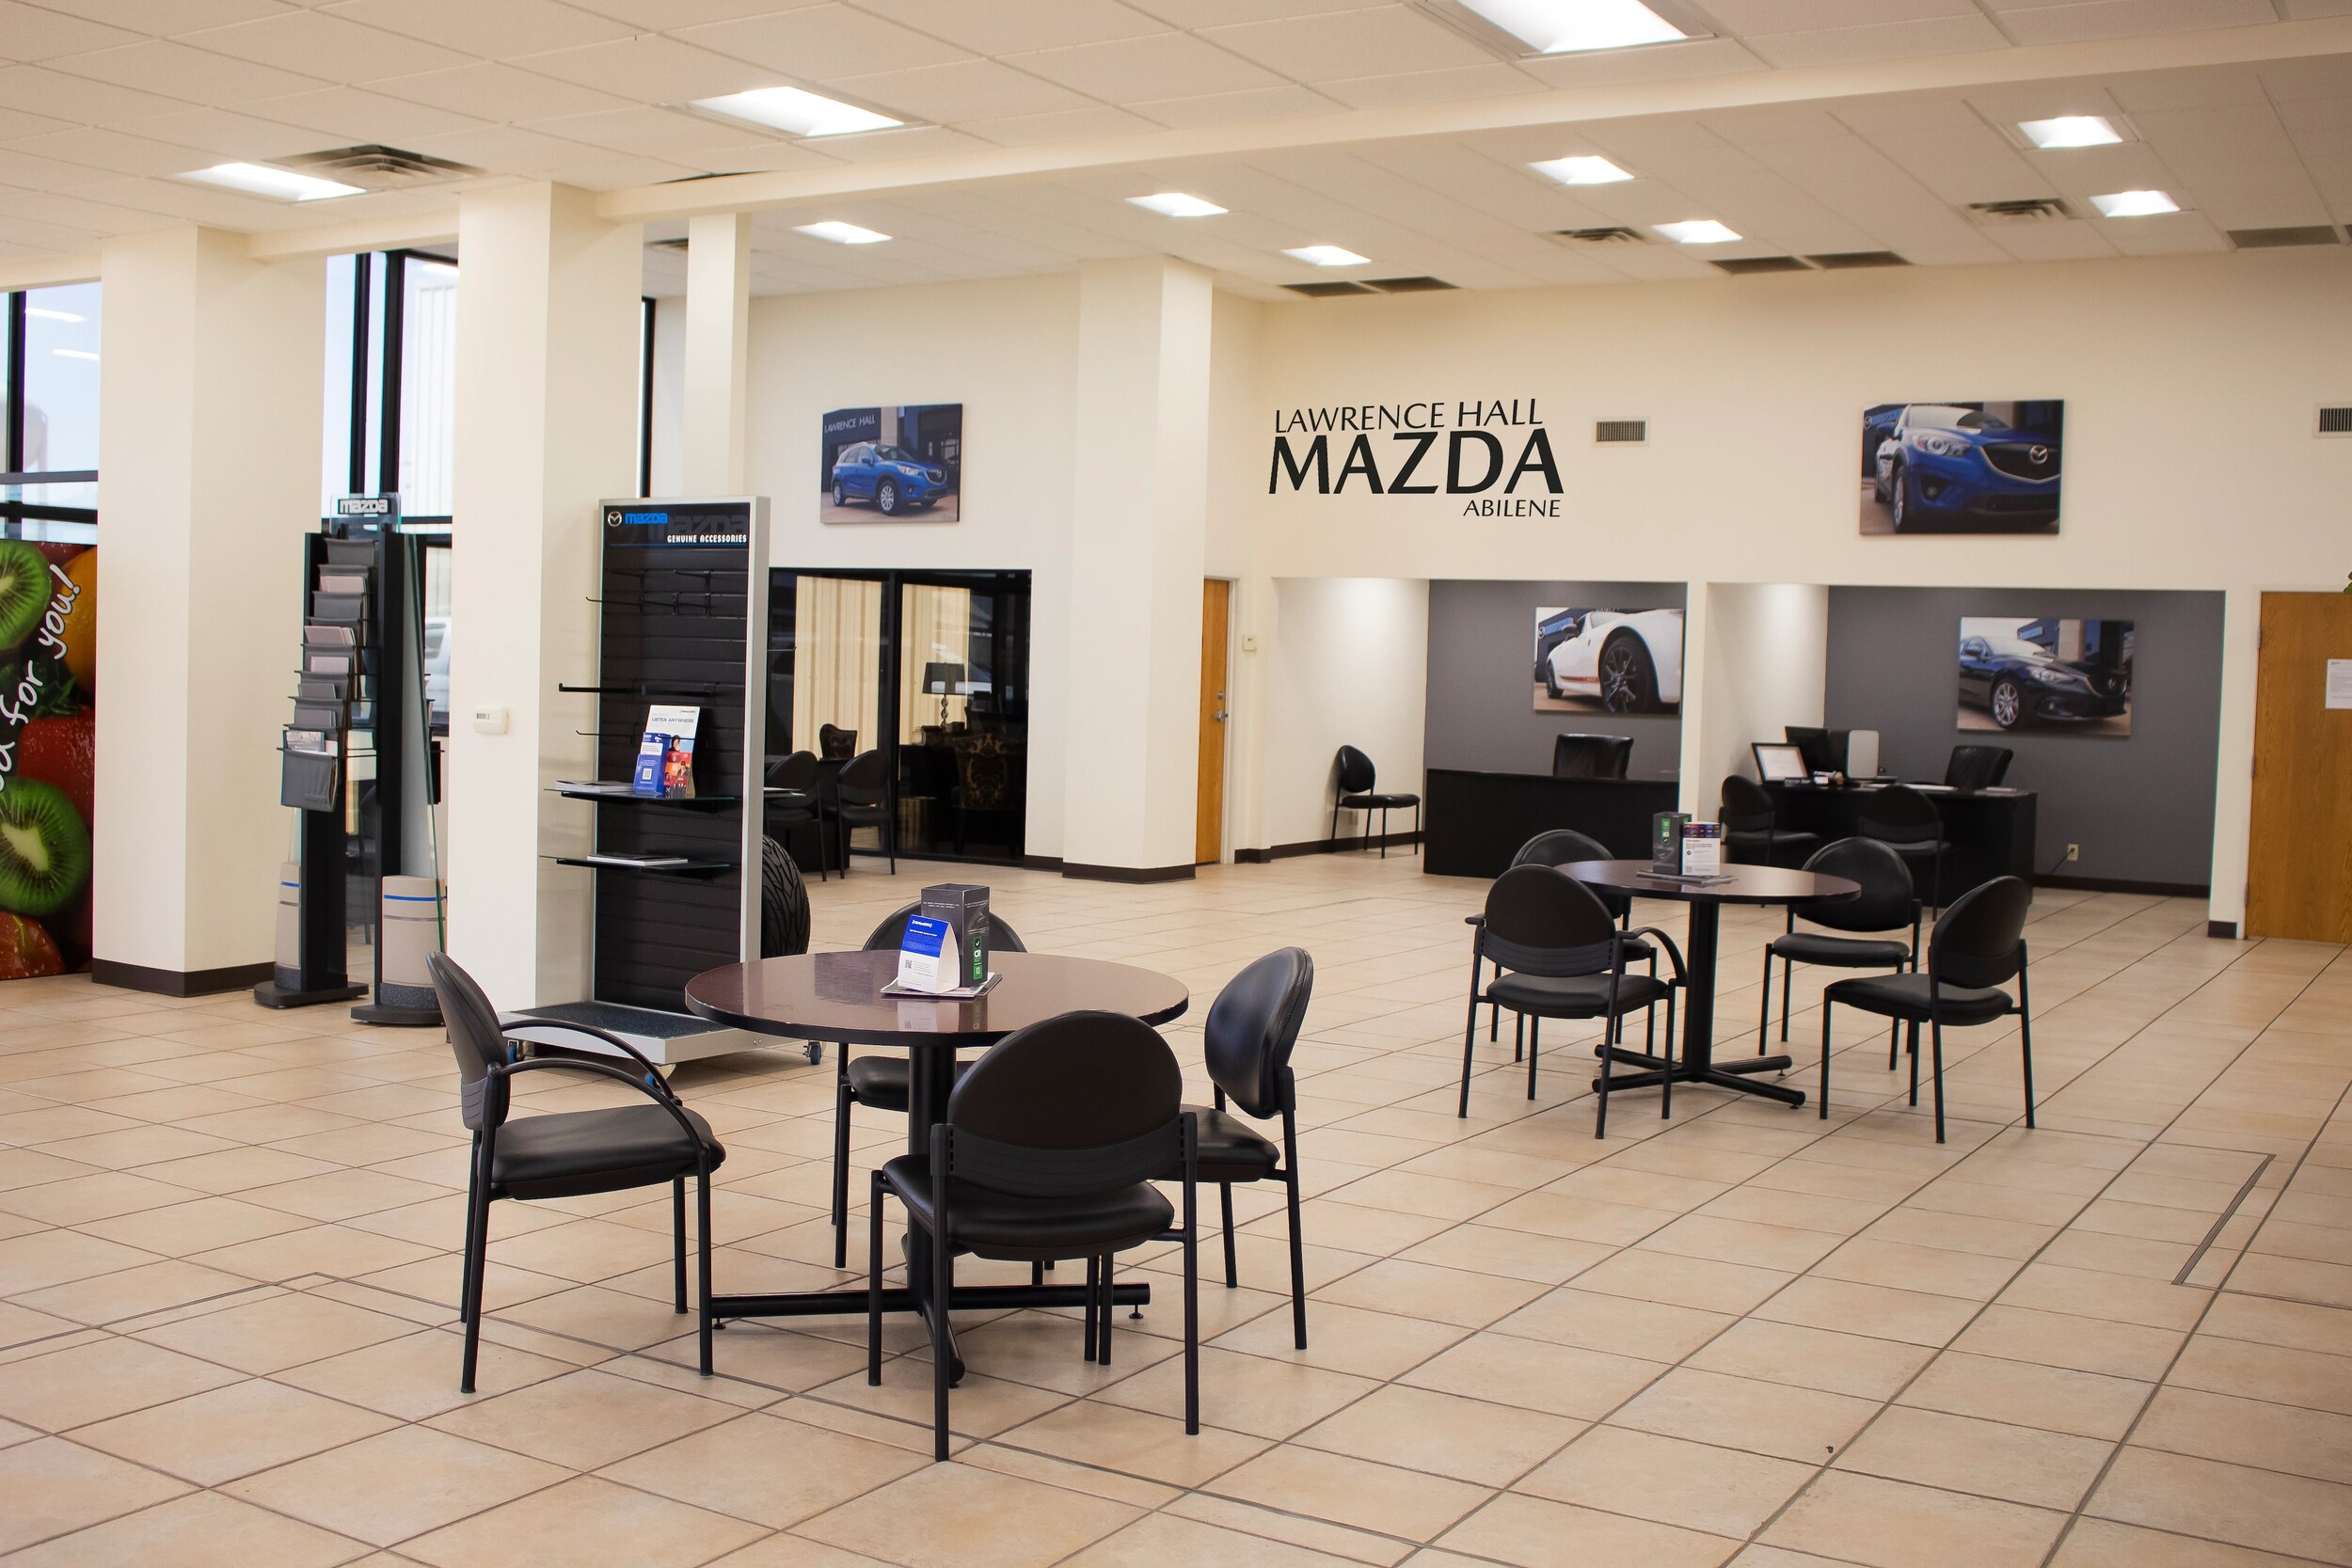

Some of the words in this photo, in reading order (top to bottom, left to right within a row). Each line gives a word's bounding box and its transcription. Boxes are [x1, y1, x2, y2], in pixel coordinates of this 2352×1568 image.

[824, 418, 857, 434] LAWRENCE
[859, 414, 876, 425] HALL
[1275, 403, 1445, 434] LAWRENCE
[1457, 398, 1544, 427] HALL
[1268, 428, 1565, 495] MAZDA
[1463, 499, 1561, 517] ABILENE
[667, 534, 697, 544] GENUINE
[700, 533, 747, 544] ACCESSORIES
[0, 659, 43, 726] for
[38, 563, 82, 660] you!
